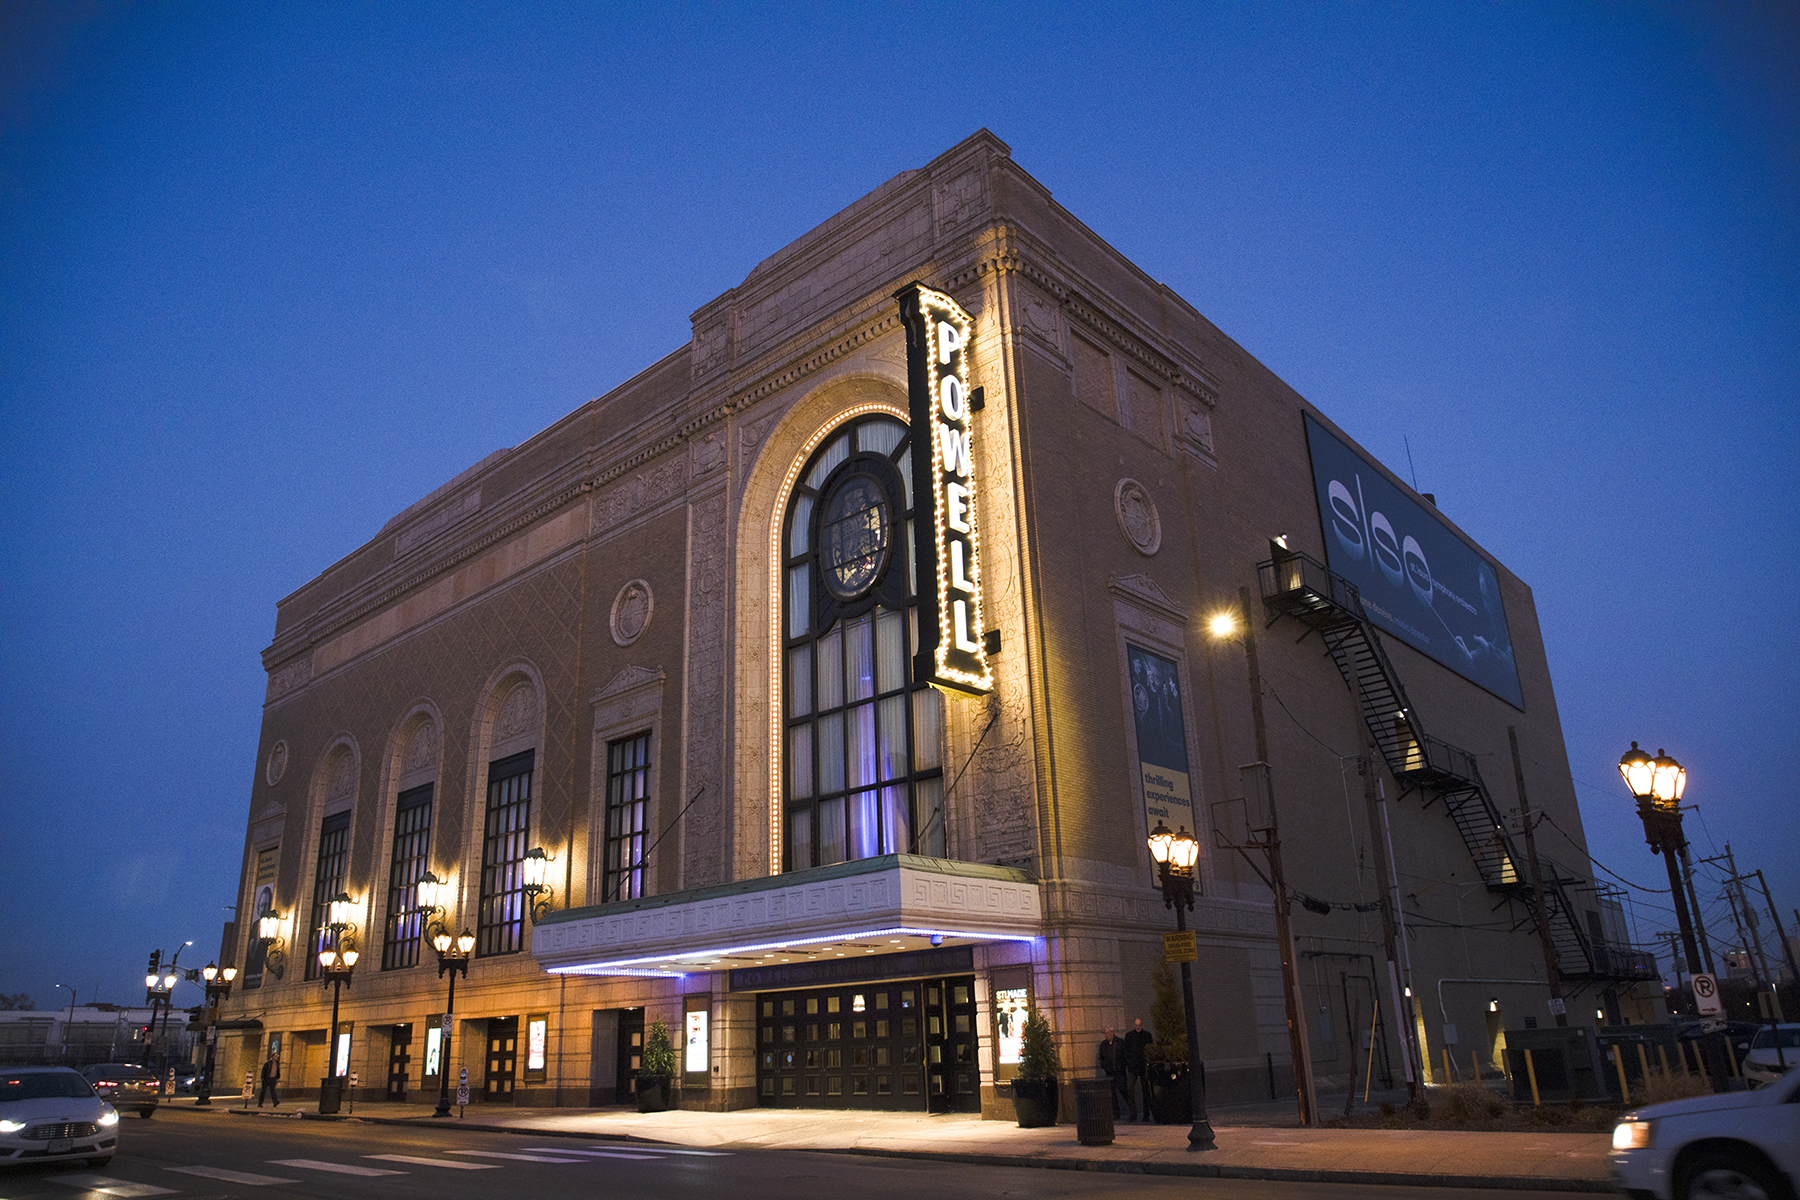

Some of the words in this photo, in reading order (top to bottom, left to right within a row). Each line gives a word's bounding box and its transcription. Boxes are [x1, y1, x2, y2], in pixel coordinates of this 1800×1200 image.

[937, 320, 978, 653] POWELL
[1144, 773, 1174, 792] thrilling
[1146, 790, 1190, 807] experiences
[1148, 806, 1169, 818] await
